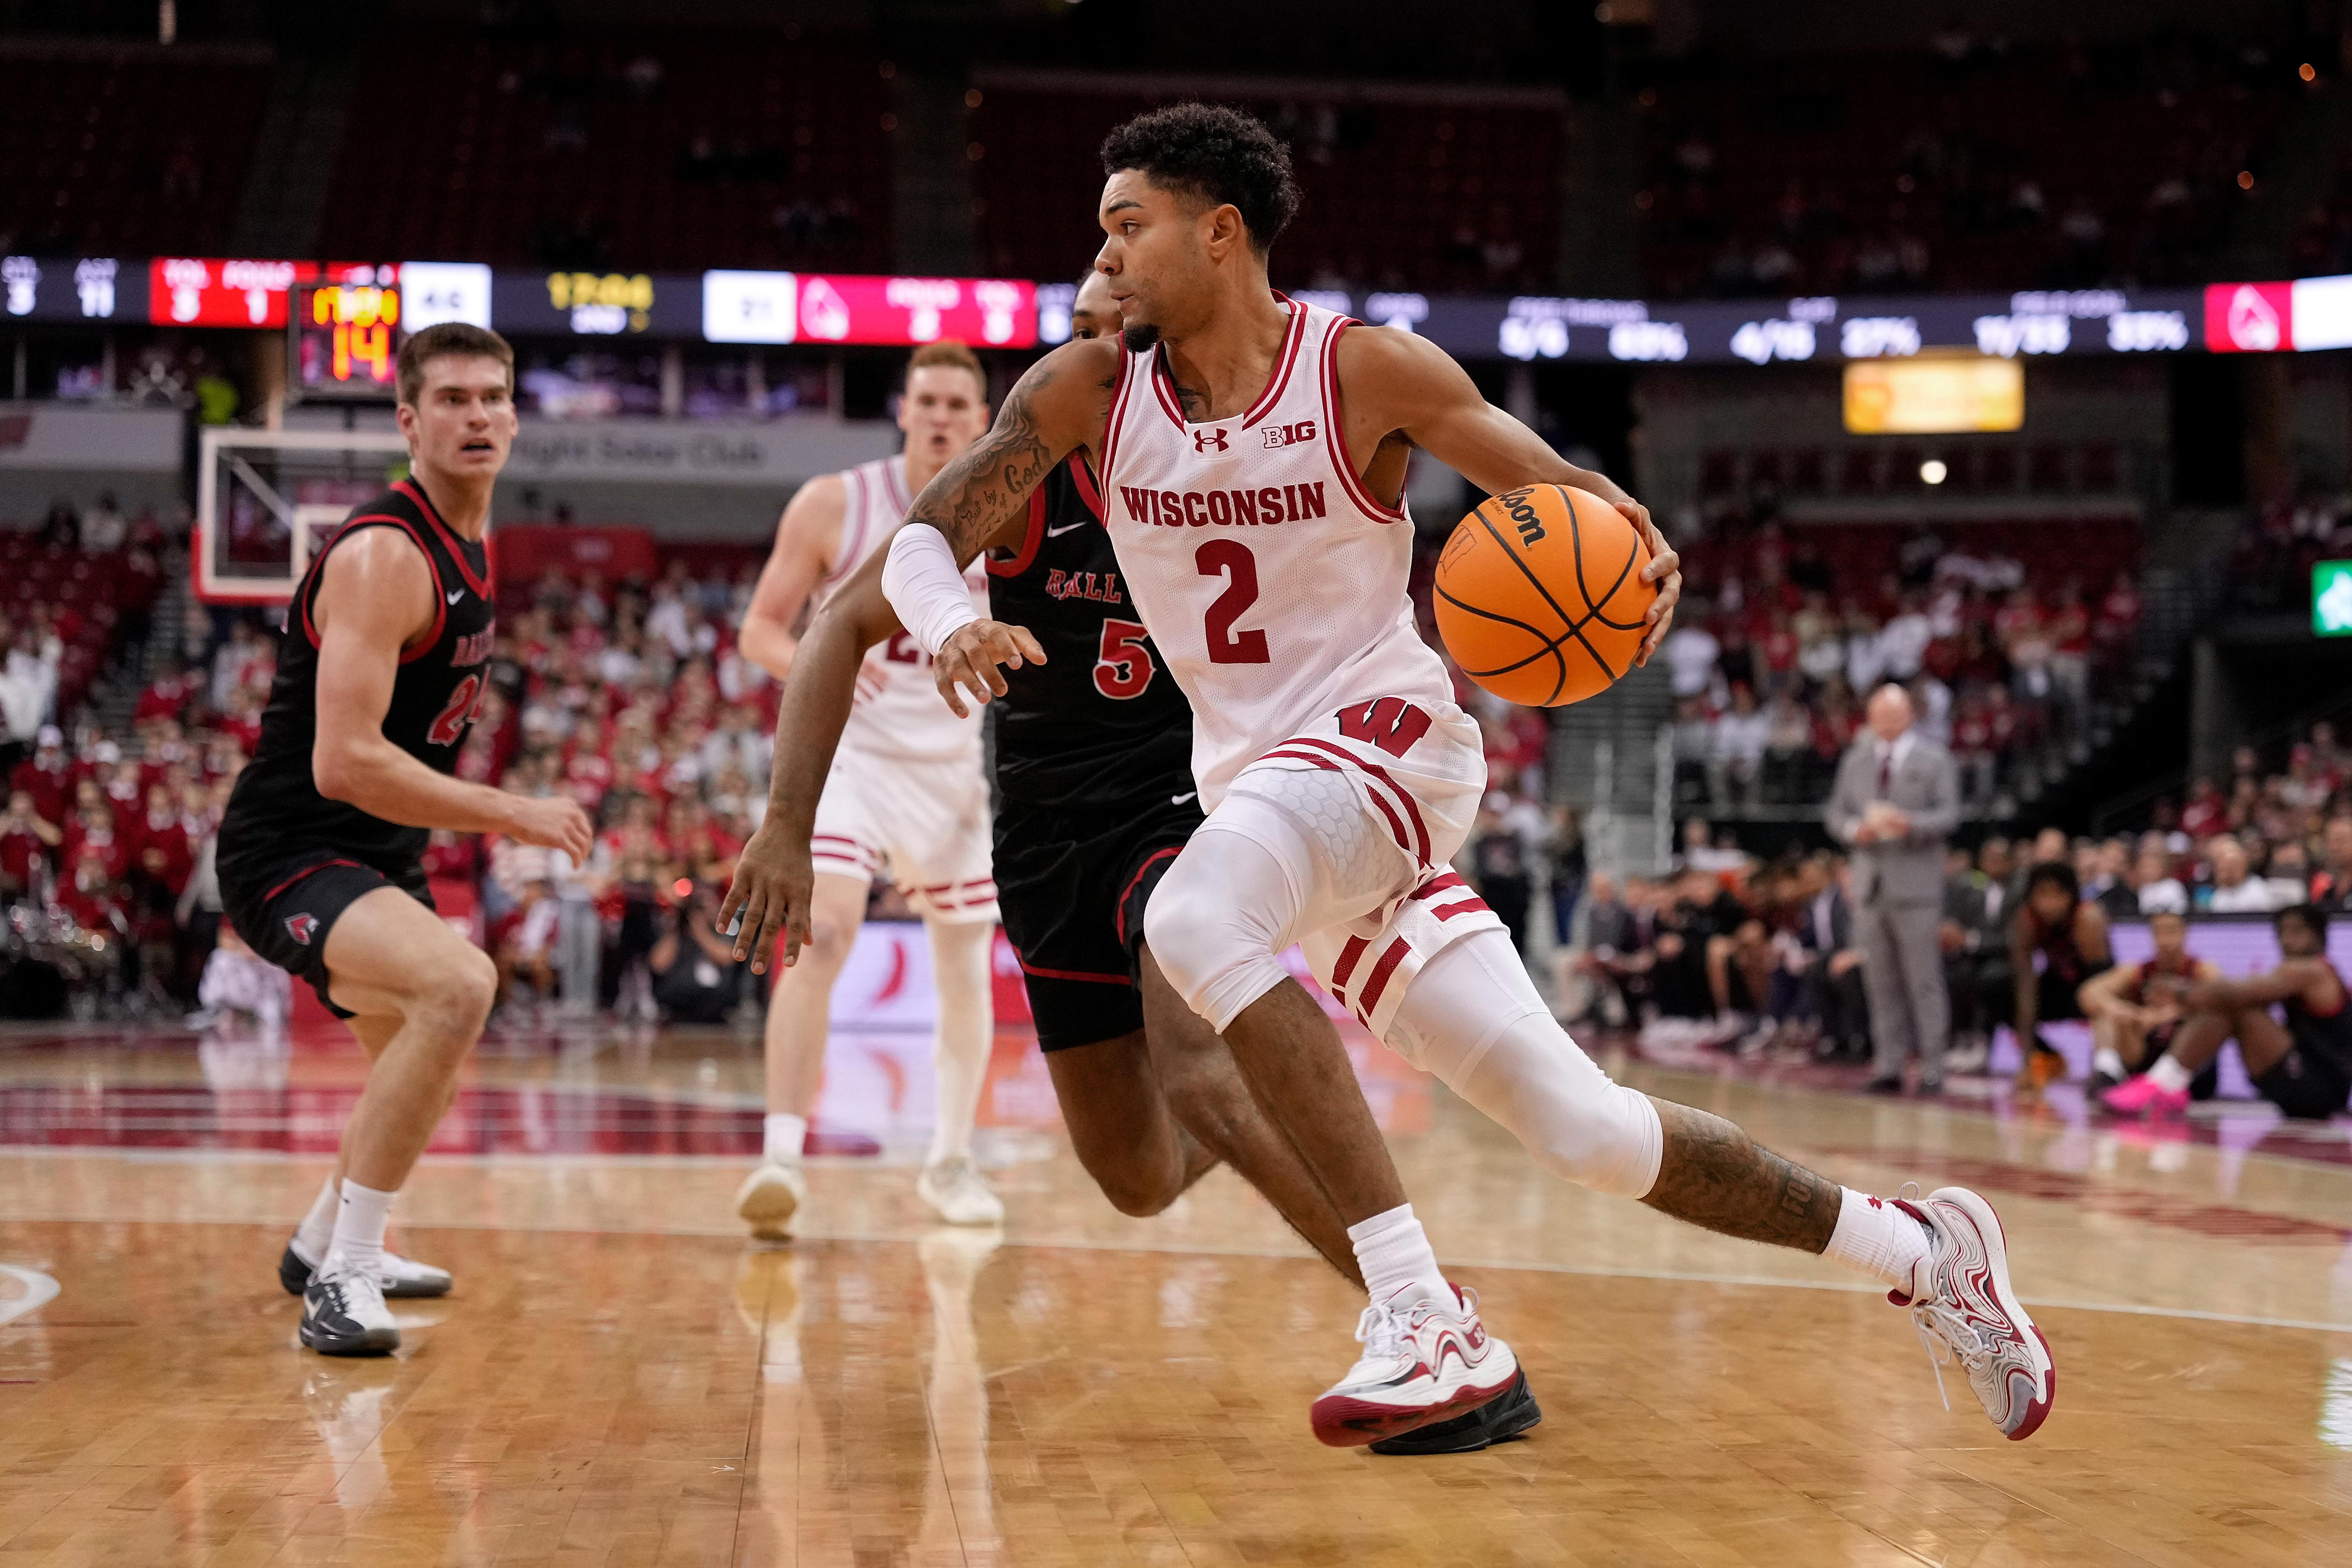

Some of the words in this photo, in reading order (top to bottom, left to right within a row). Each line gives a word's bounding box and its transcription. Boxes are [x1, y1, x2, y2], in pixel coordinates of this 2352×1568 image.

[1005, 447, 1046, 494] God
[1120, 481, 1327, 527] WISCONSIN
[1496, 486, 1547, 548] lson
[1045, 567, 1122, 604] BALL
[1195, 539, 1271, 664] 2
[1093, 618, 1157, 700] 5
[1333, 697, 1433, 759] W
